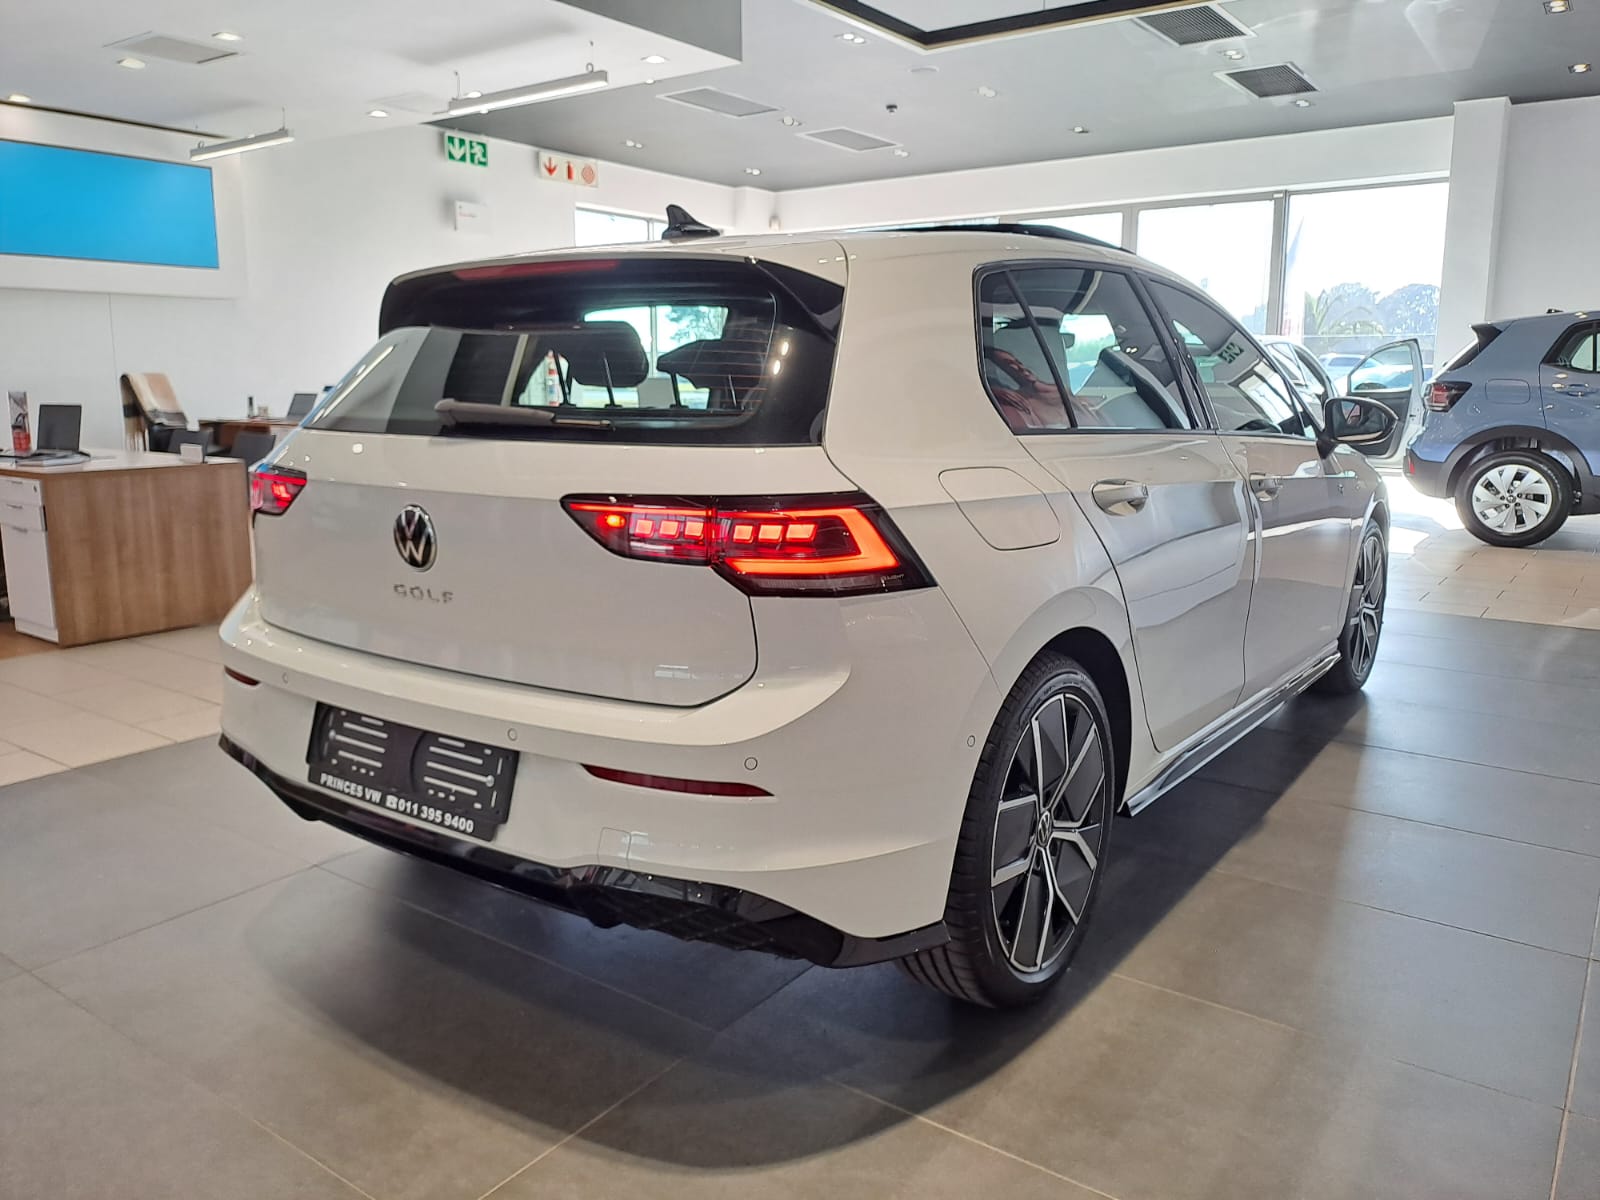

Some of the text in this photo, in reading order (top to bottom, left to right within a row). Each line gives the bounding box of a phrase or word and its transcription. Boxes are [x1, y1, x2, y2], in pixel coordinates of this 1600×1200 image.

[393, 583, 454, 603] GOLF
[320, 773, 474, 833] PRINCES VW 011 395 9400
